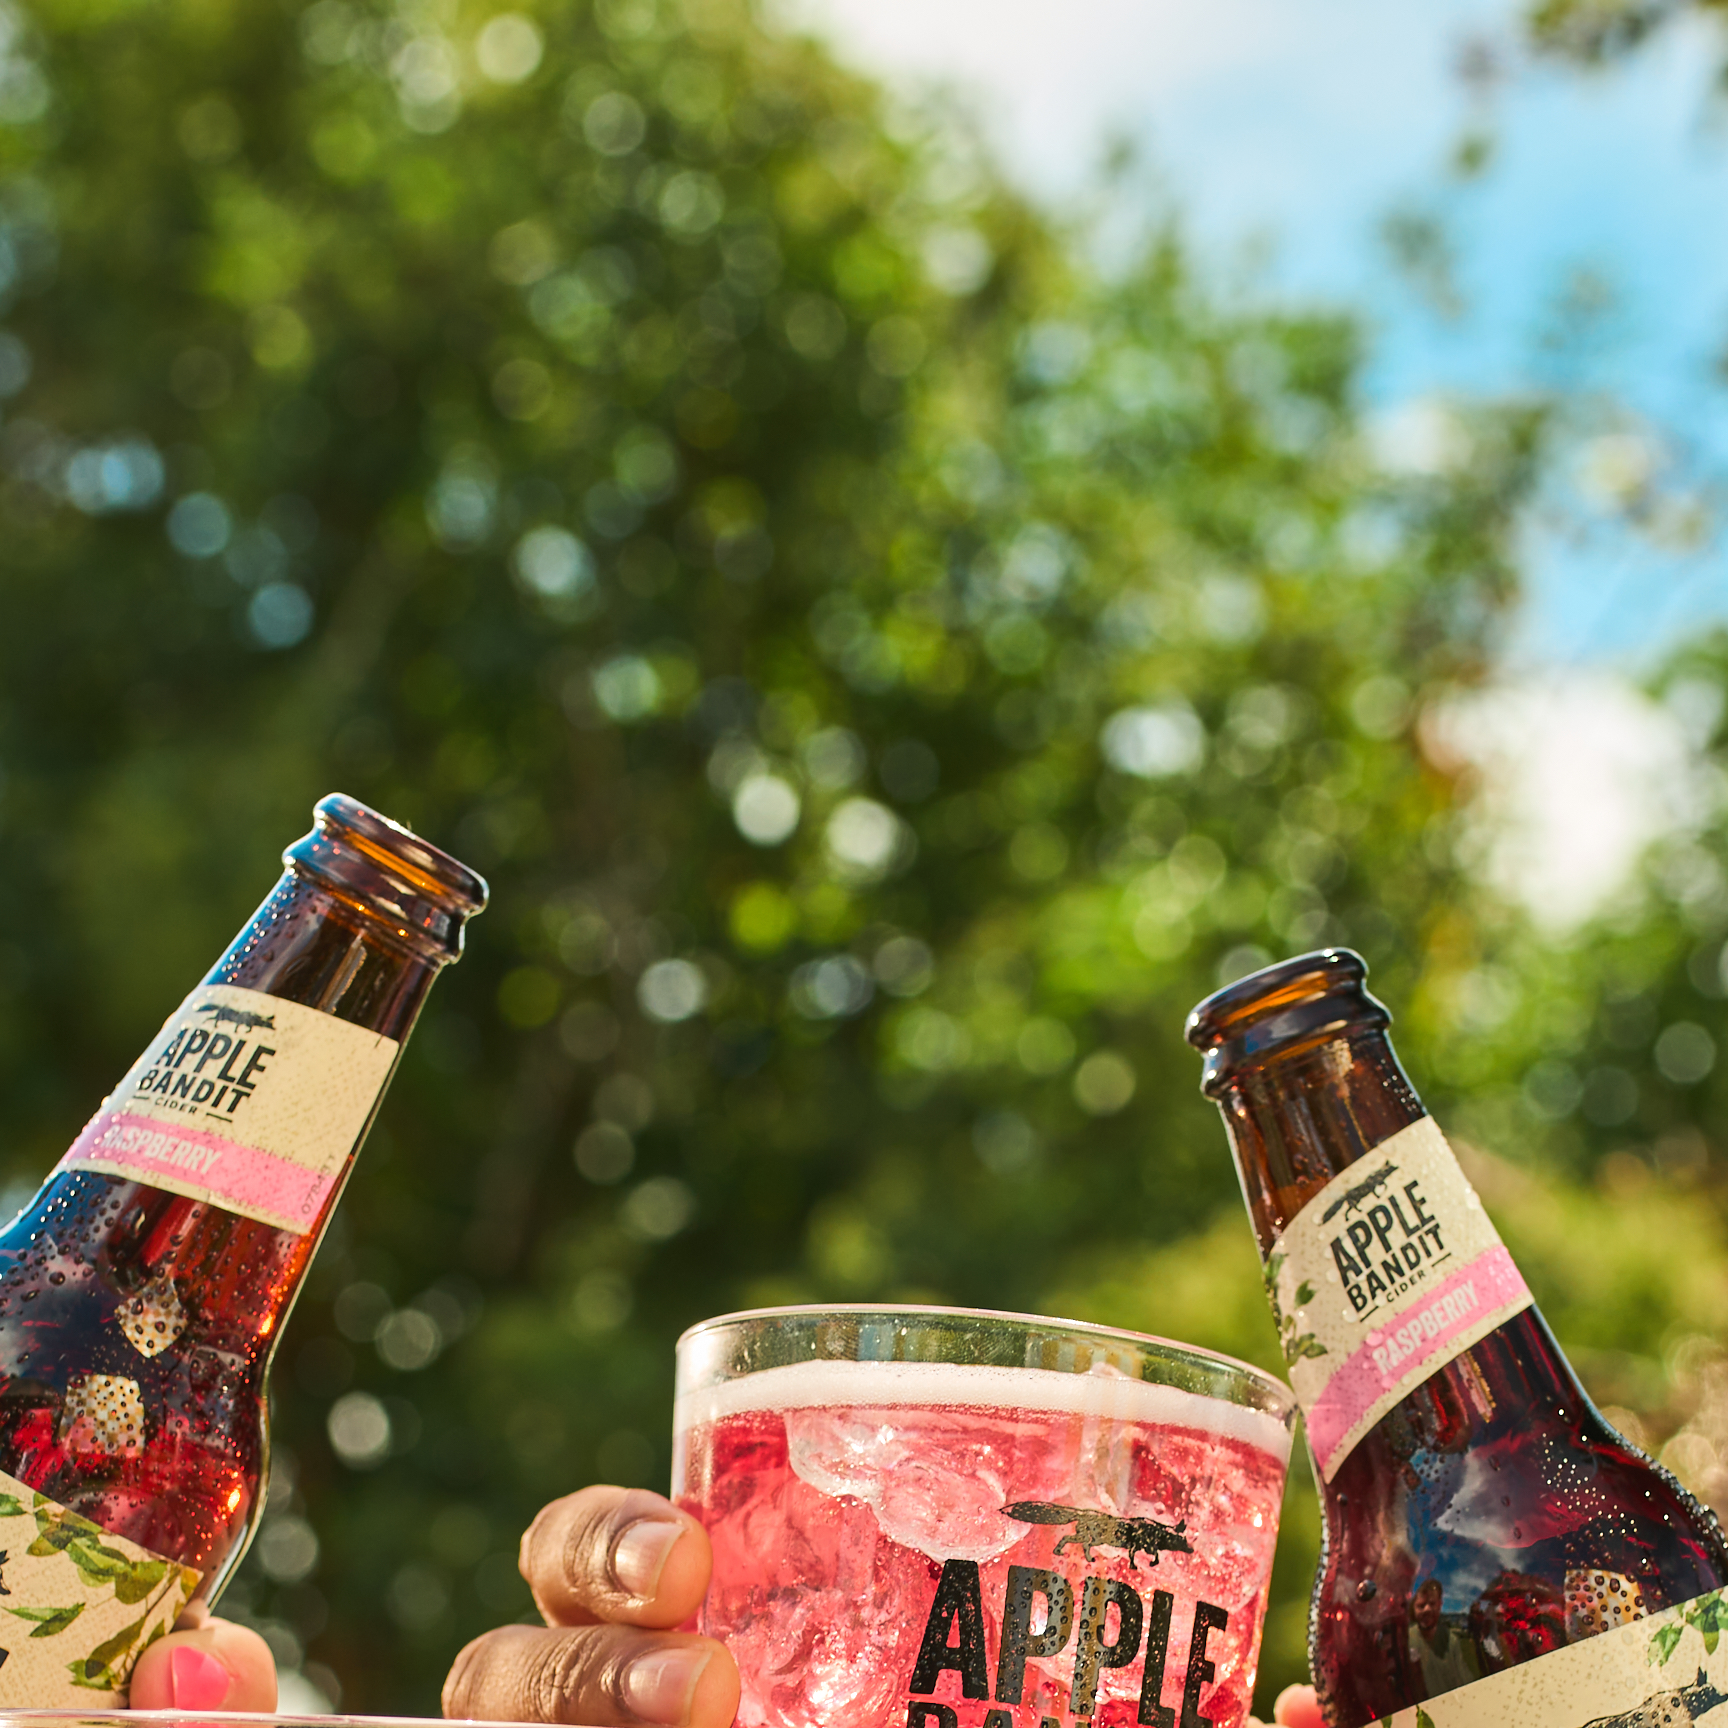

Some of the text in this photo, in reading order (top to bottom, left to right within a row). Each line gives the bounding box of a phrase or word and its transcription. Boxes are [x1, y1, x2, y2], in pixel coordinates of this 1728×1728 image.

[155, 1028, 276, 1090] APPLE
[139, 1069, 251, 1113] BANDIT
[154, 1097, 198, 1115] CIDER
[100, 1124, 221, 1175] RASPBERRY
[1330, 1179, 1435, 1289] APPLE
[1345, 1223, 1445, 1314] BANDIT
[1386, 1271, 1427, 1303] CIDER
[1371, 1280, 1480, 1376] RASPBERRY
